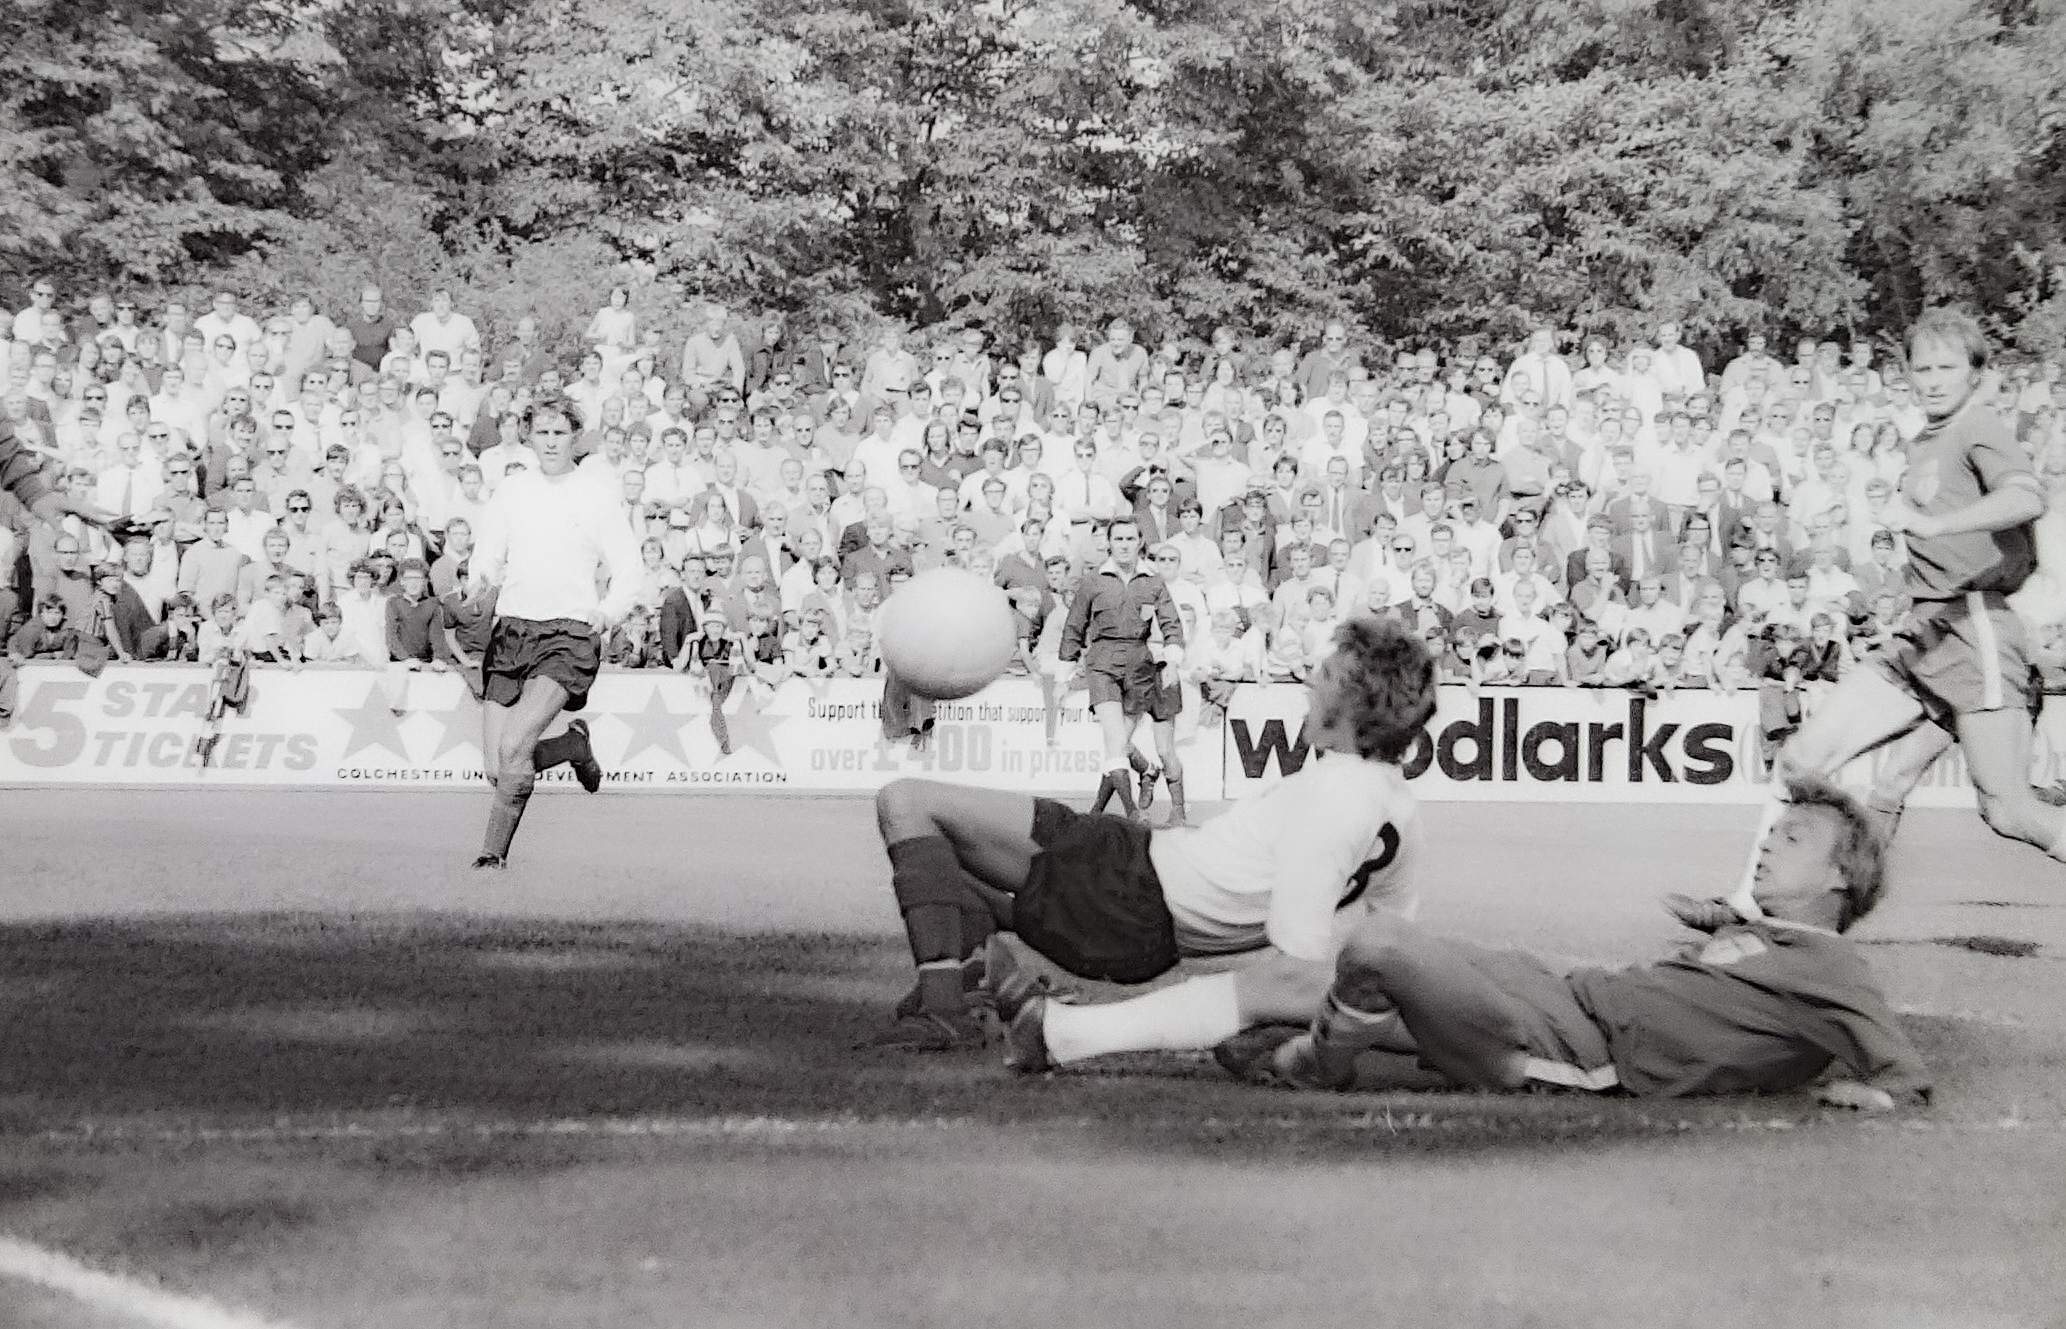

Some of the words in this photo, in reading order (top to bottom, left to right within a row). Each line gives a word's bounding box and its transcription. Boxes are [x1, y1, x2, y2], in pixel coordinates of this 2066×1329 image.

[8, 680, 91, 768] 5
[808, 697, 865, 721] Support
[979, 702, 1003, 721] that
[94, 731, 319, 771] TICKETS
[810, 748, 869, 771] over
[1001, 738, 1023, 772] in
[1031, 748, 1100, 779] prizes
[337, 768, 454, 780] COLCHESTER
[666, 771, 788, 783] ASSOCIATION
